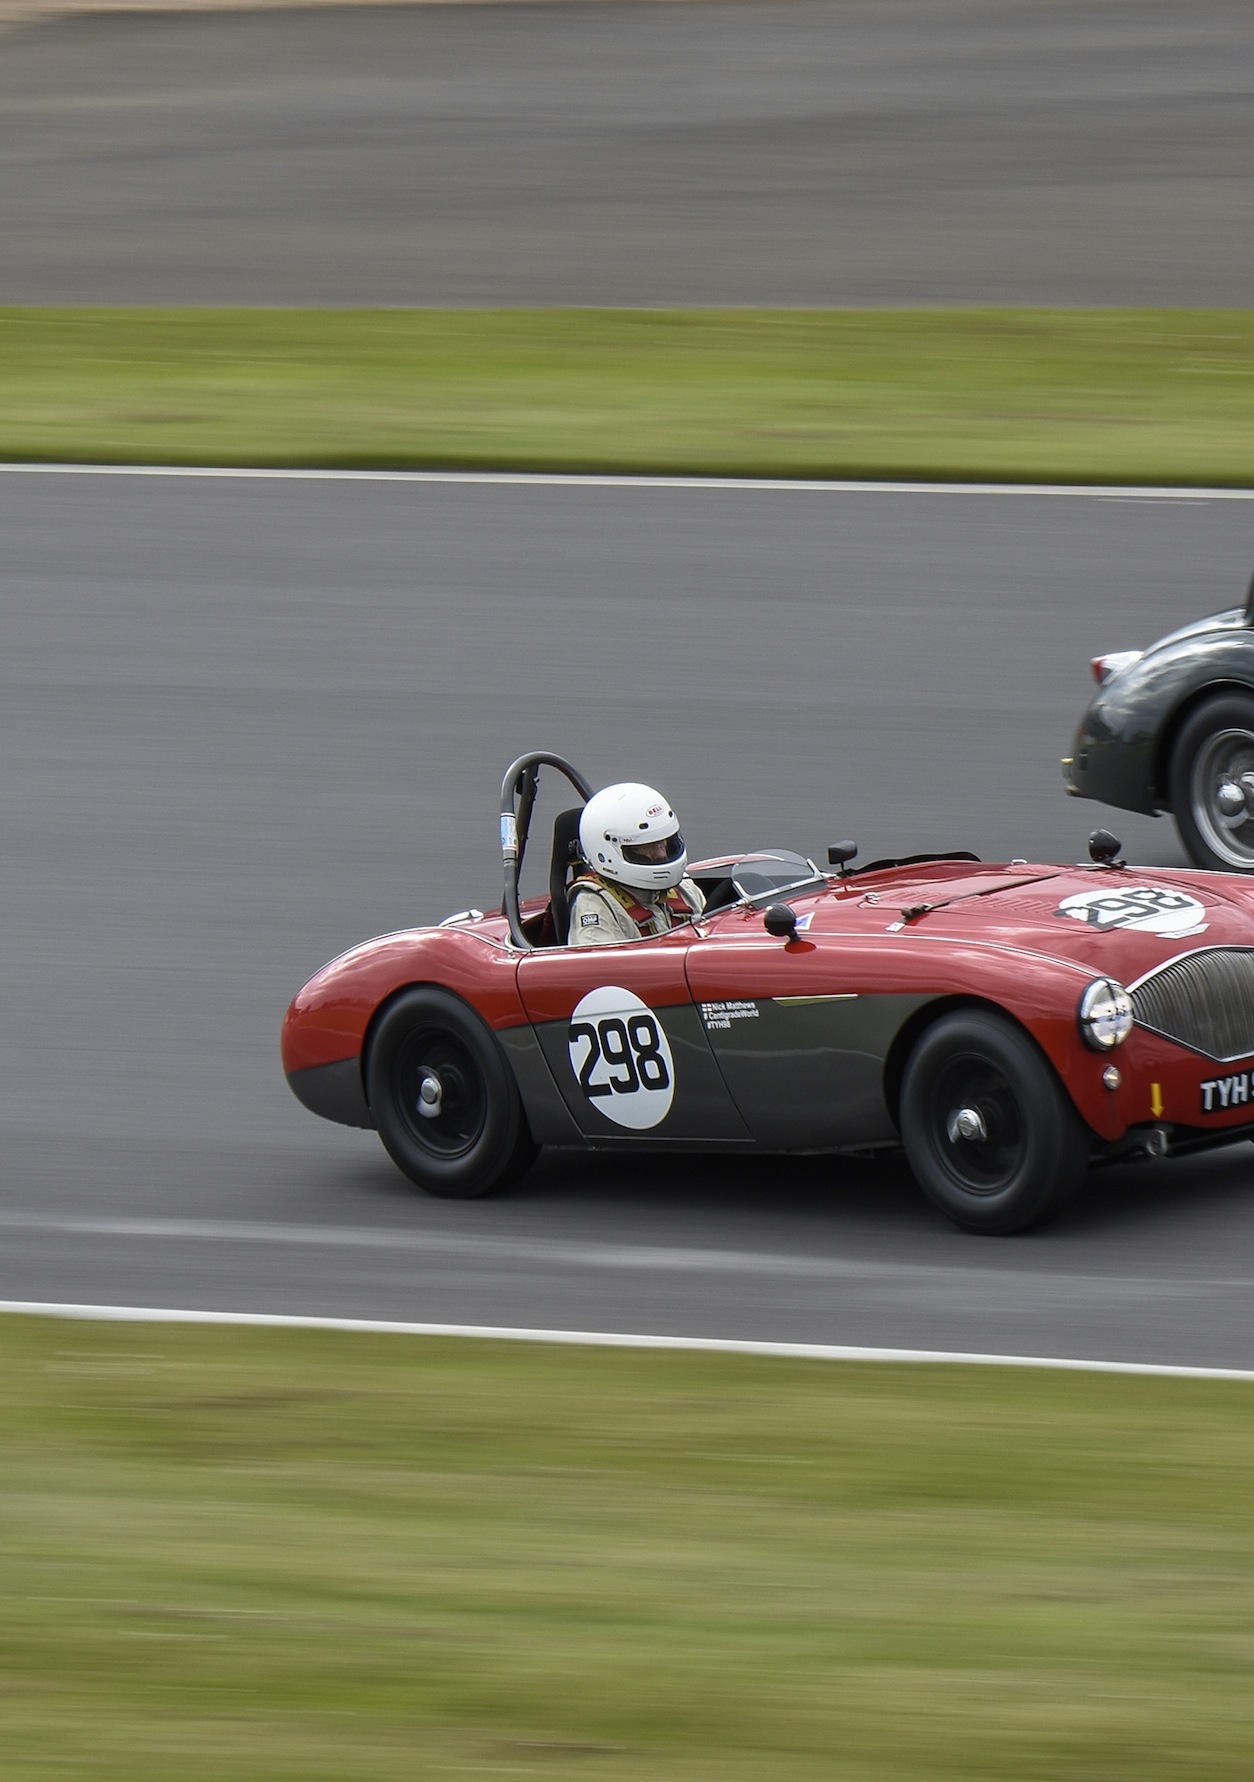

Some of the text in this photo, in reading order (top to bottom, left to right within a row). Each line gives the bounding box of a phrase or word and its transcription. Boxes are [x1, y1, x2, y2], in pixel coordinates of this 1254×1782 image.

[1052, 890, 1195, 931] 298
[568, 1014, 670, 1098] 298
[1200, 1073, 1248, 1111] TYH
